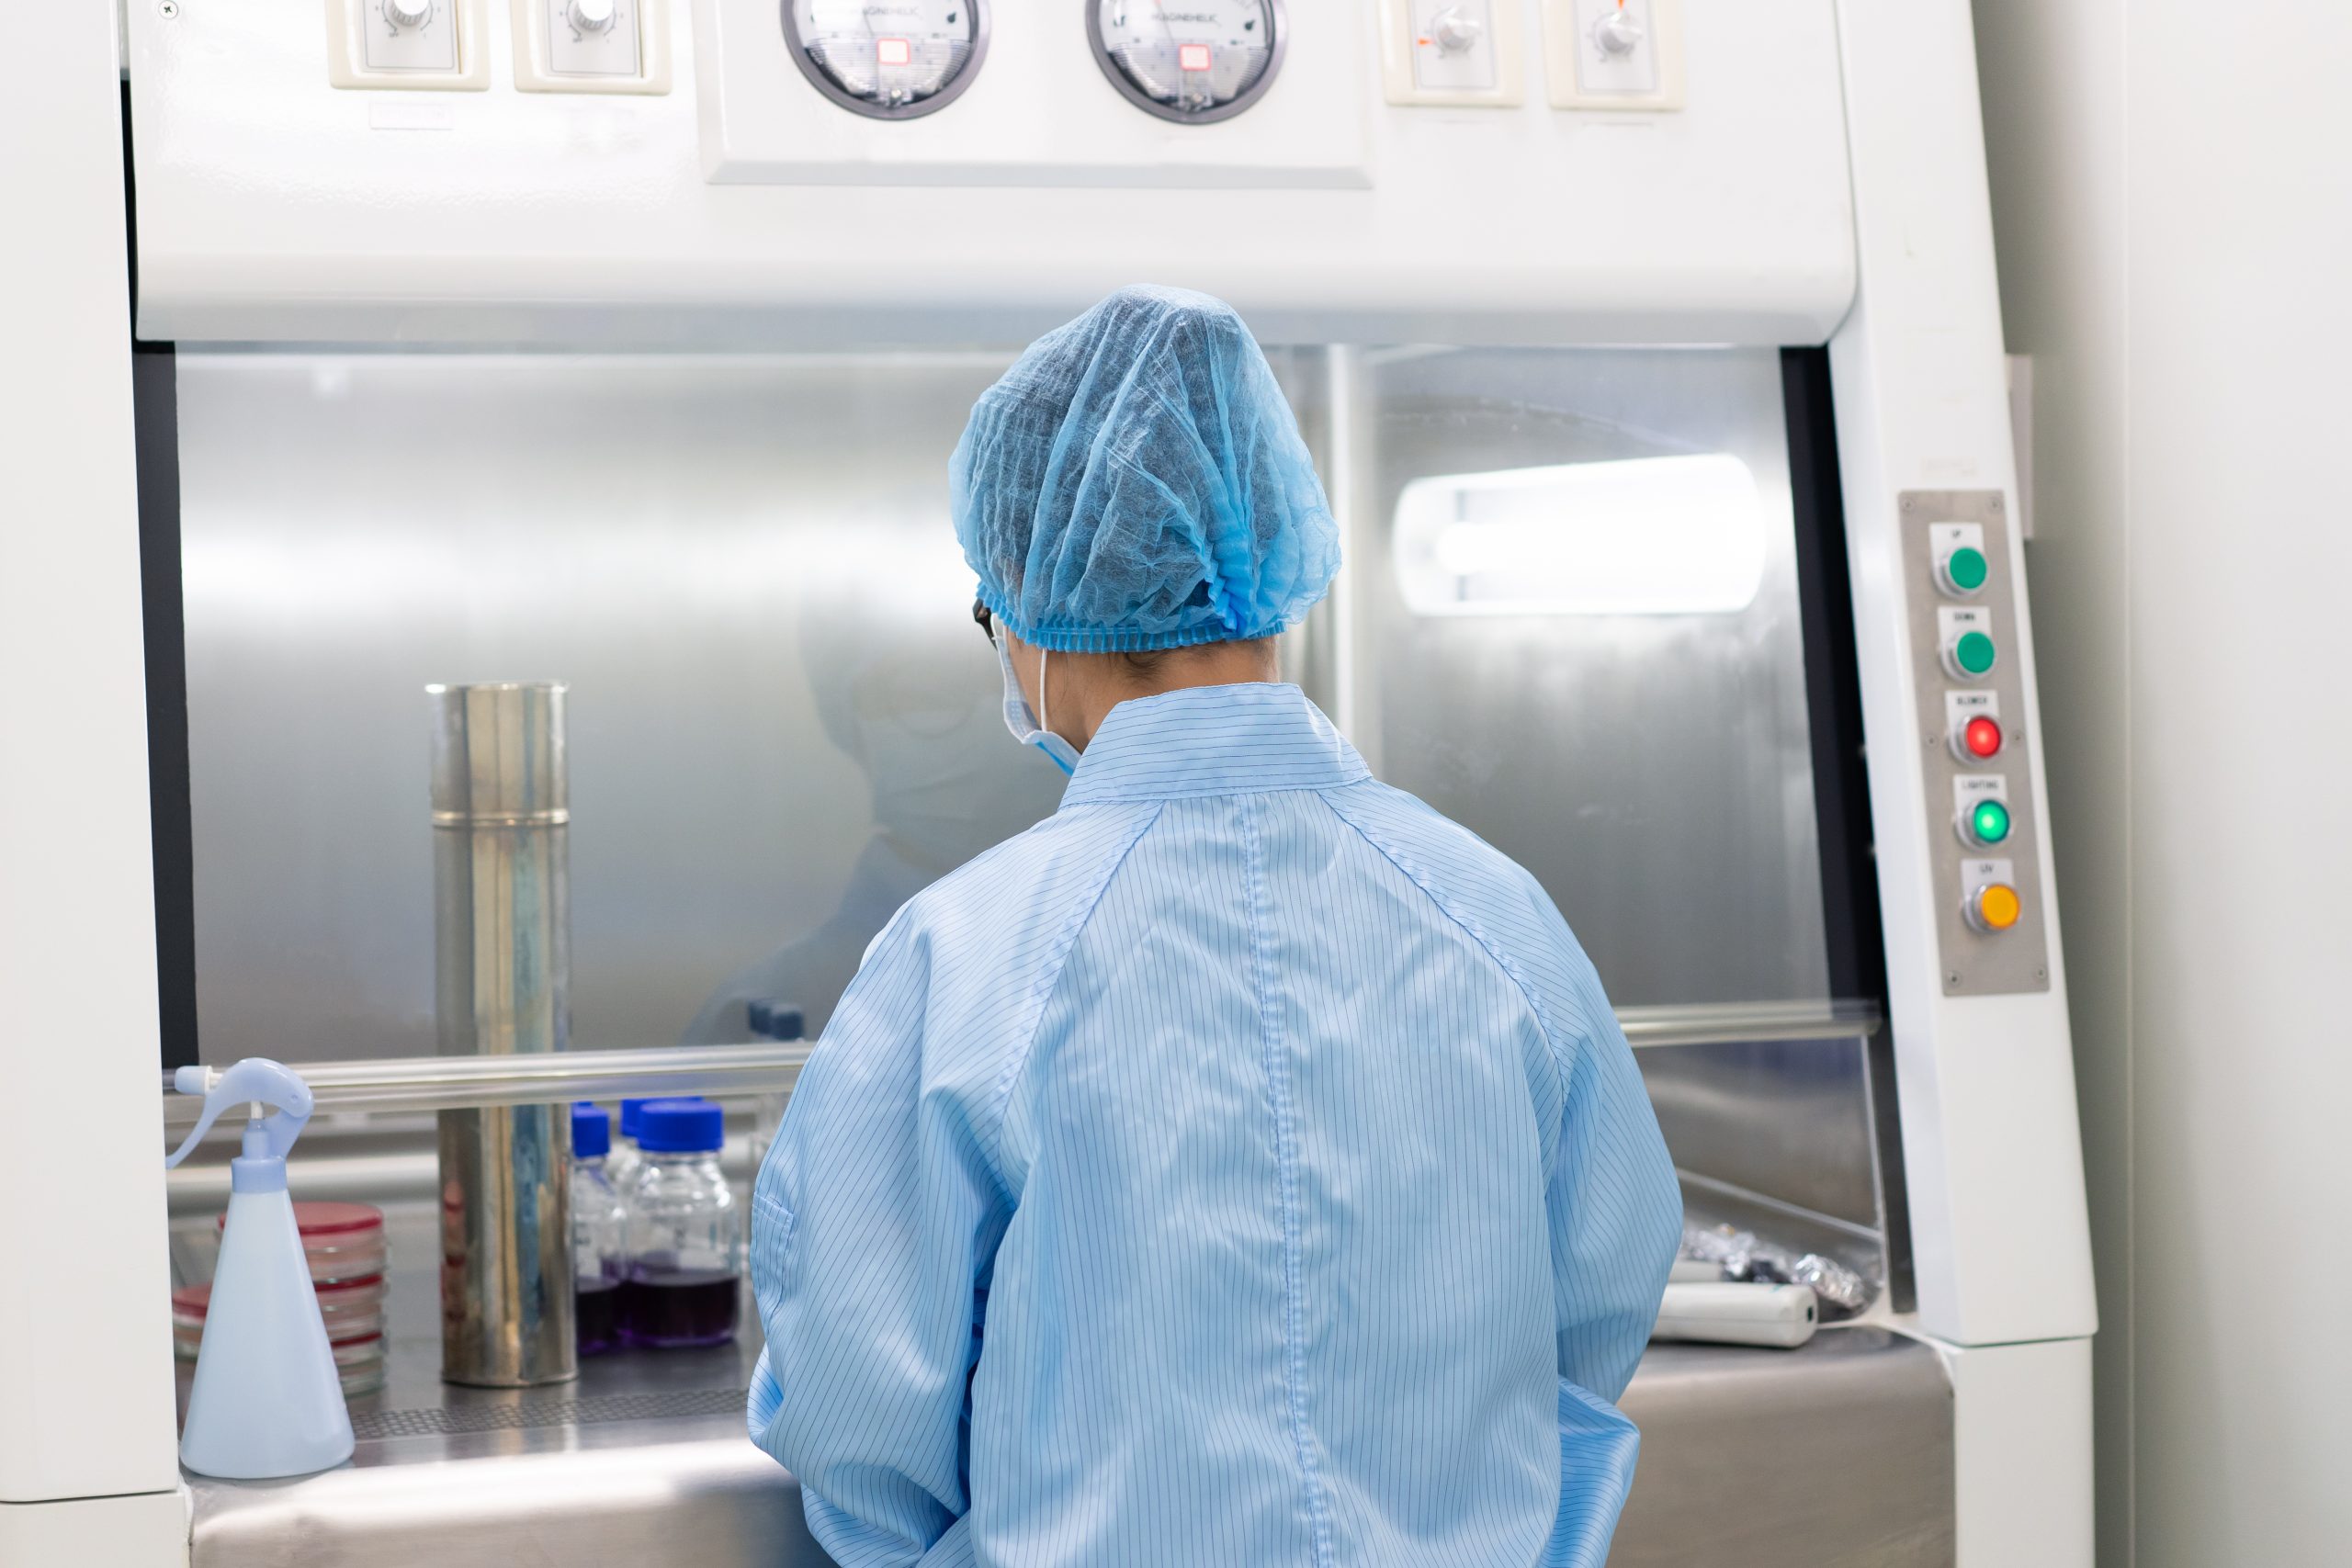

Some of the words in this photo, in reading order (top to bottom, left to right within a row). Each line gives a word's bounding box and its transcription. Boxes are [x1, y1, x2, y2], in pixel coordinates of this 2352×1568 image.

[1952, 529, 1962, 538] UP
[1953, 612, 1975, 621] DOWN
[1957, 696, 1987, 705] BLOWER
[1962, 780, 1999, 789] LIGHTING
[1980, 863, 1993, 874] UV
